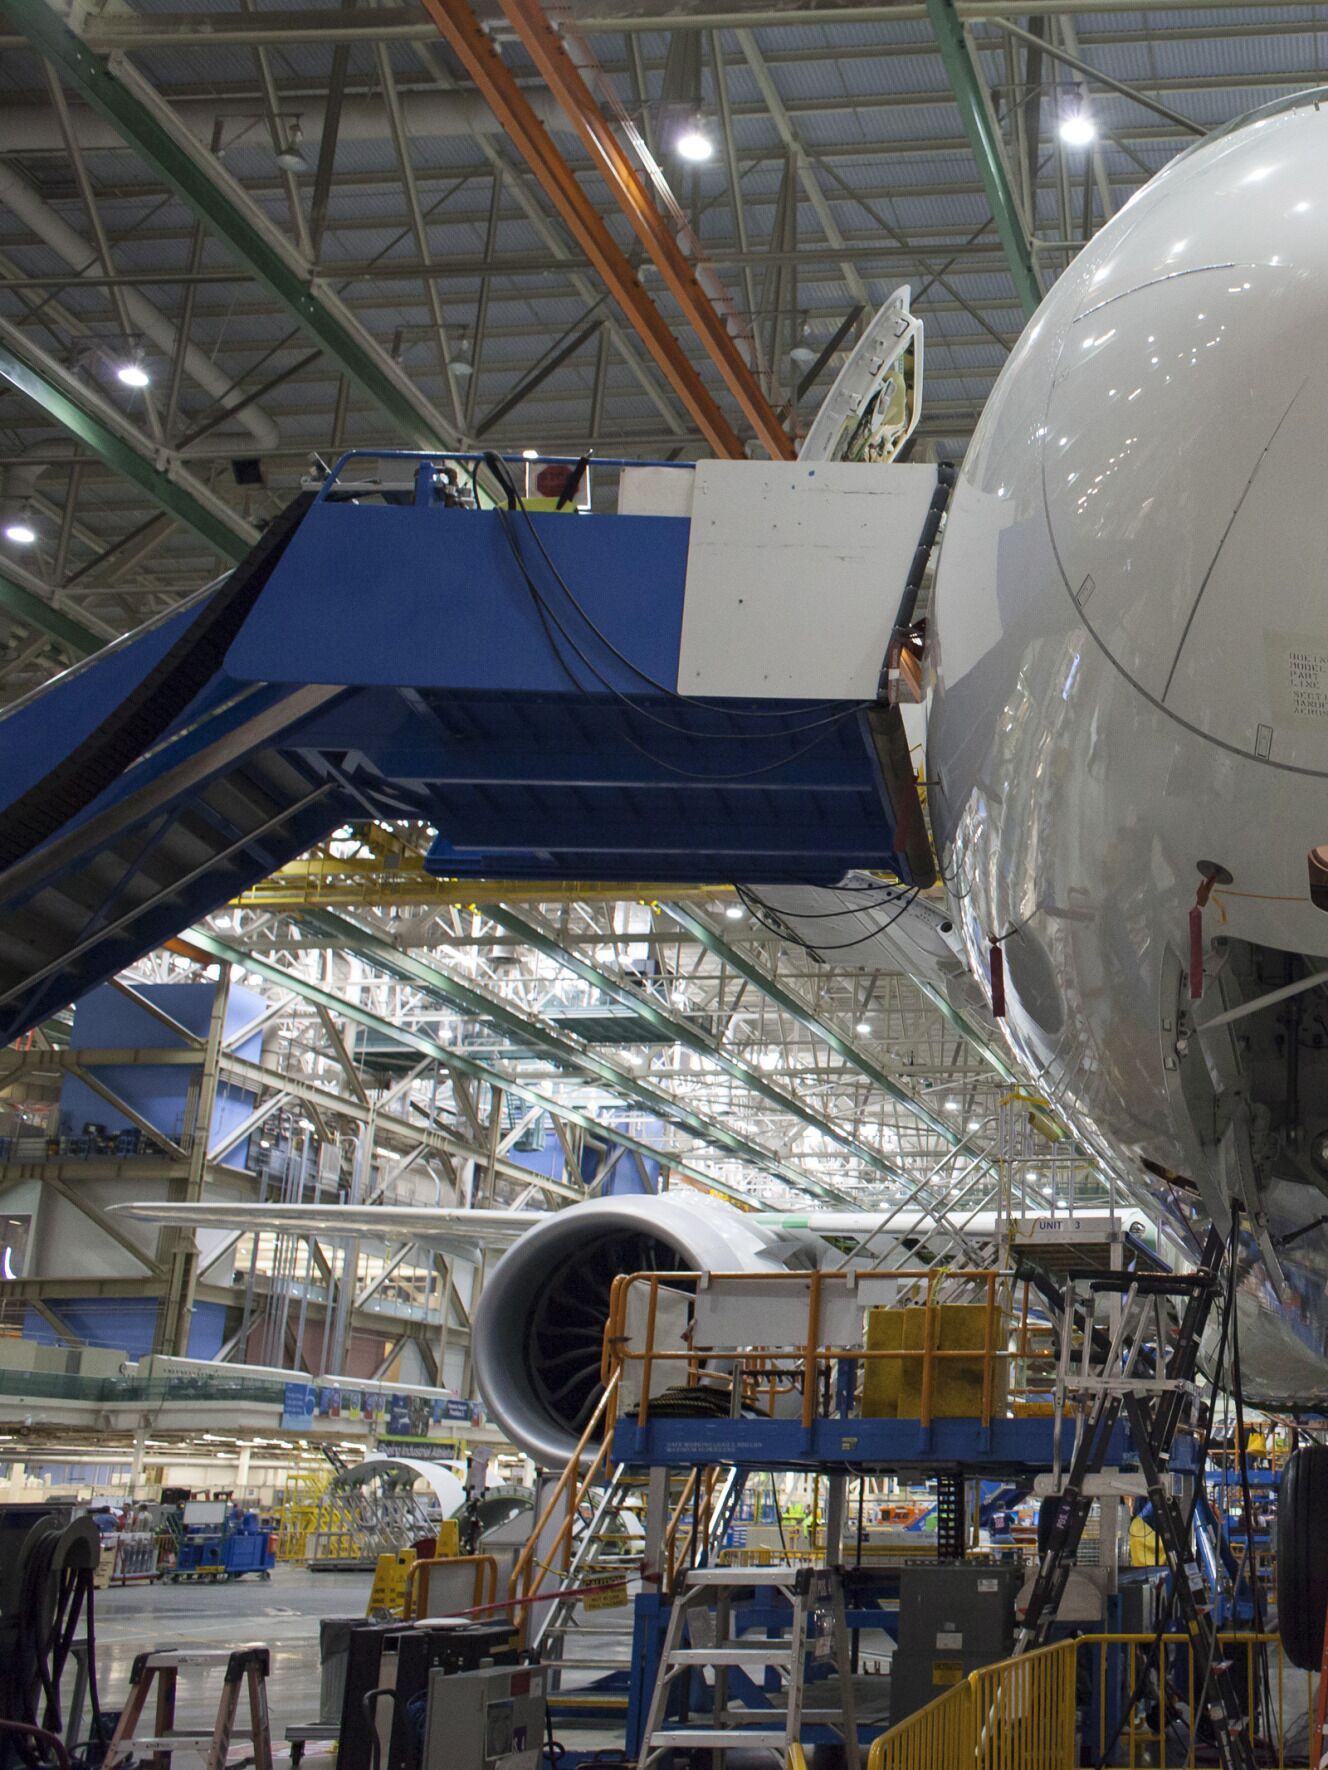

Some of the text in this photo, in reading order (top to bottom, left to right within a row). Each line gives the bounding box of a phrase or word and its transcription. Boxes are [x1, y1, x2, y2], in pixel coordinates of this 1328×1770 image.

[1289, 662, 1327, 673] MODEL
[1289, 671, 1318, 680] PART
[1290, 679, 1321, 690] LINE
[1039, 1220, 1081, 1230] UNIT 3
